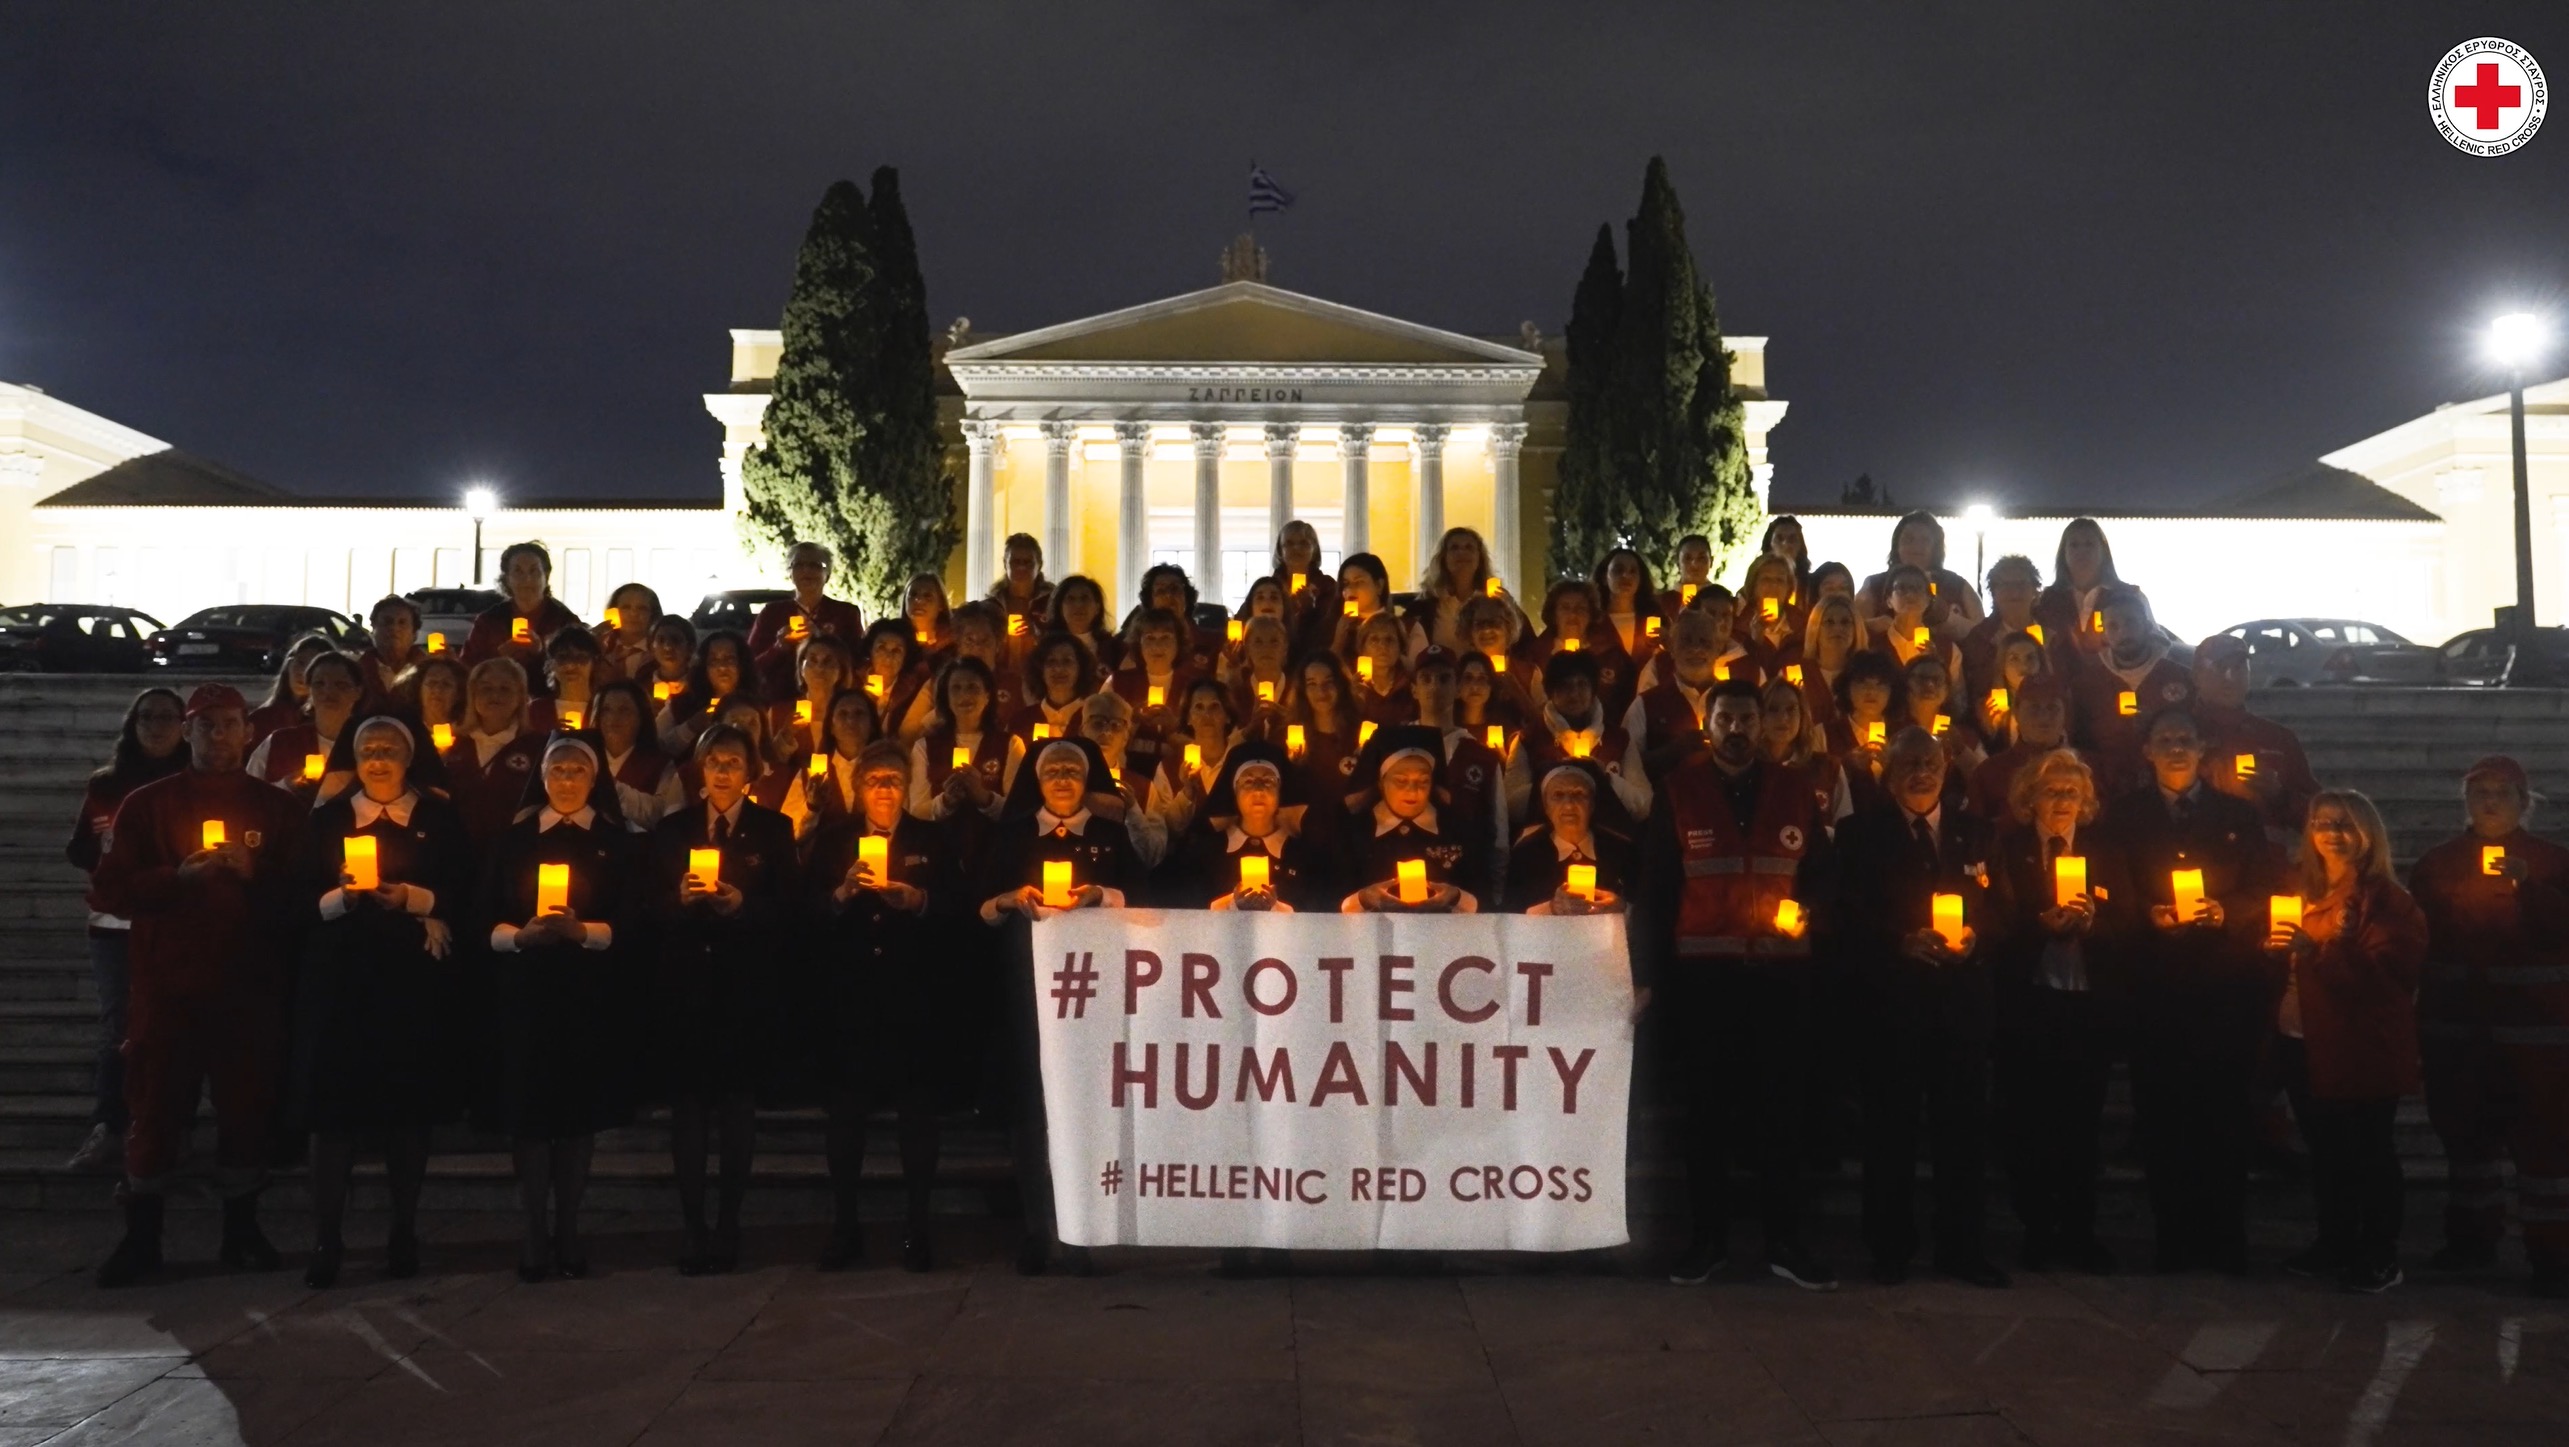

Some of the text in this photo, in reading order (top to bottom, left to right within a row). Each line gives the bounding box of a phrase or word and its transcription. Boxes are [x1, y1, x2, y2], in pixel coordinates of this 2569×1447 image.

[1111, 1041, 1596, 1114] HUMANITY
[1139, 1163, 1328, 1204] HELLENIC
[1351, 1167, 1427, 1202] RED
[1449, 1164, 1593, 1203] CROSS
